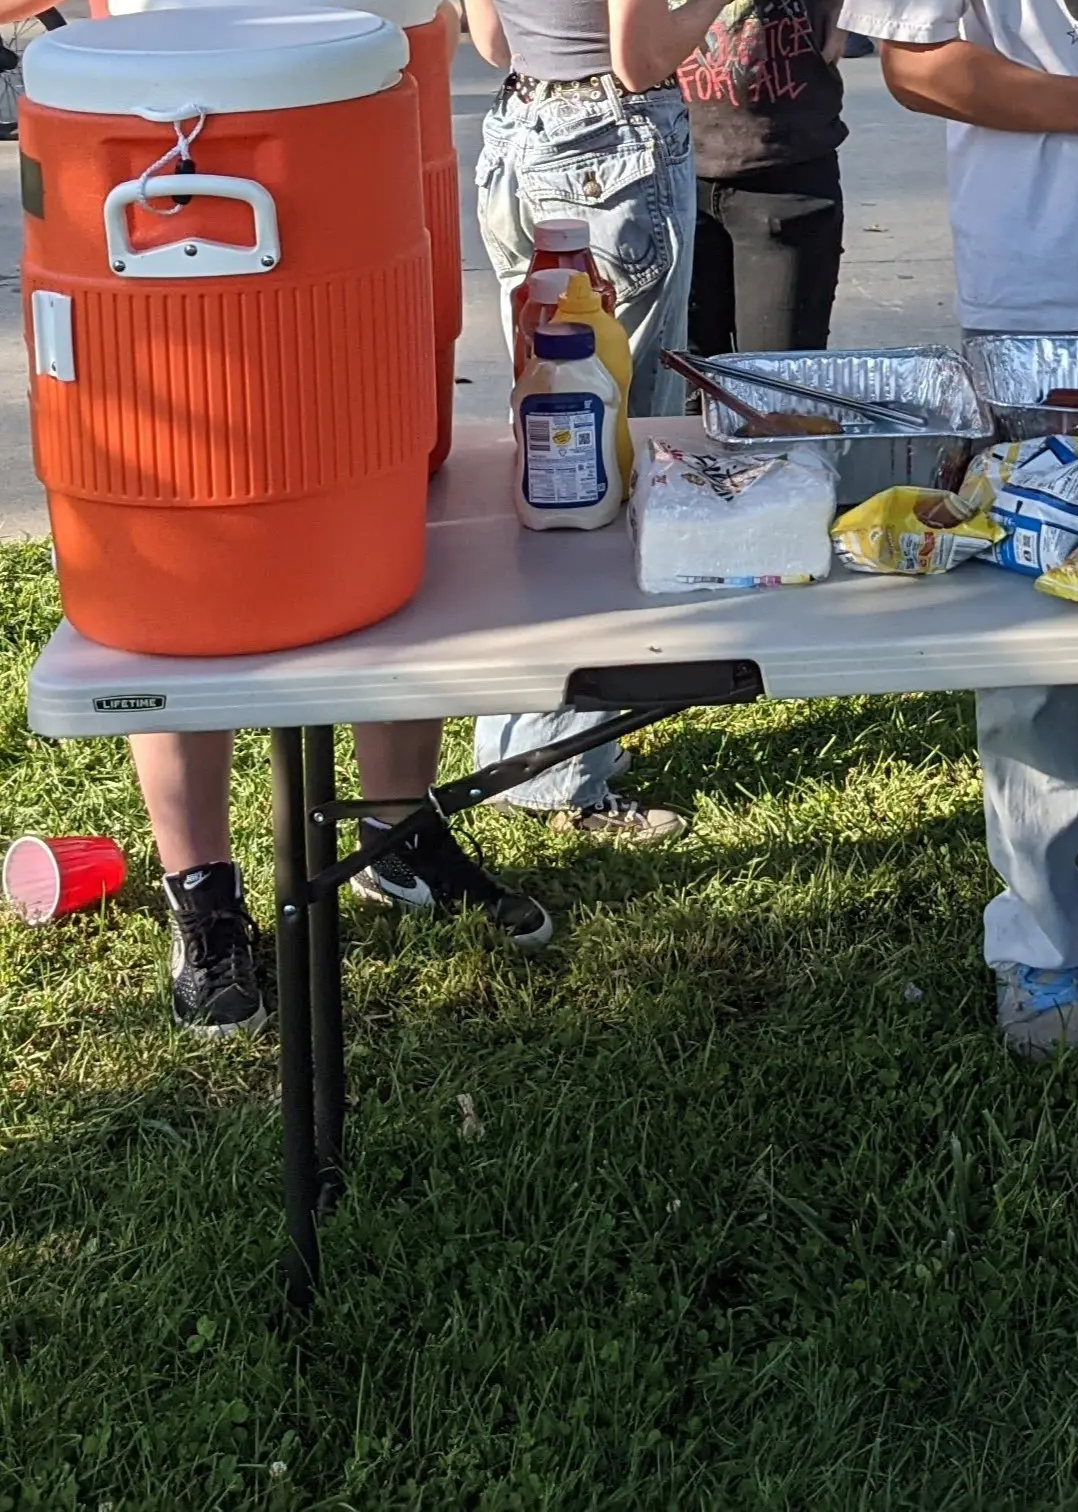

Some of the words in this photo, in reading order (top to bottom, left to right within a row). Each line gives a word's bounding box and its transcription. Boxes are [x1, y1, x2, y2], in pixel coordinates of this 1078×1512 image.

[676, 58, 740, 108] FOR
[748, 59, 808, 104] ALL
[102, 697, 157, 710] LIFETIME
